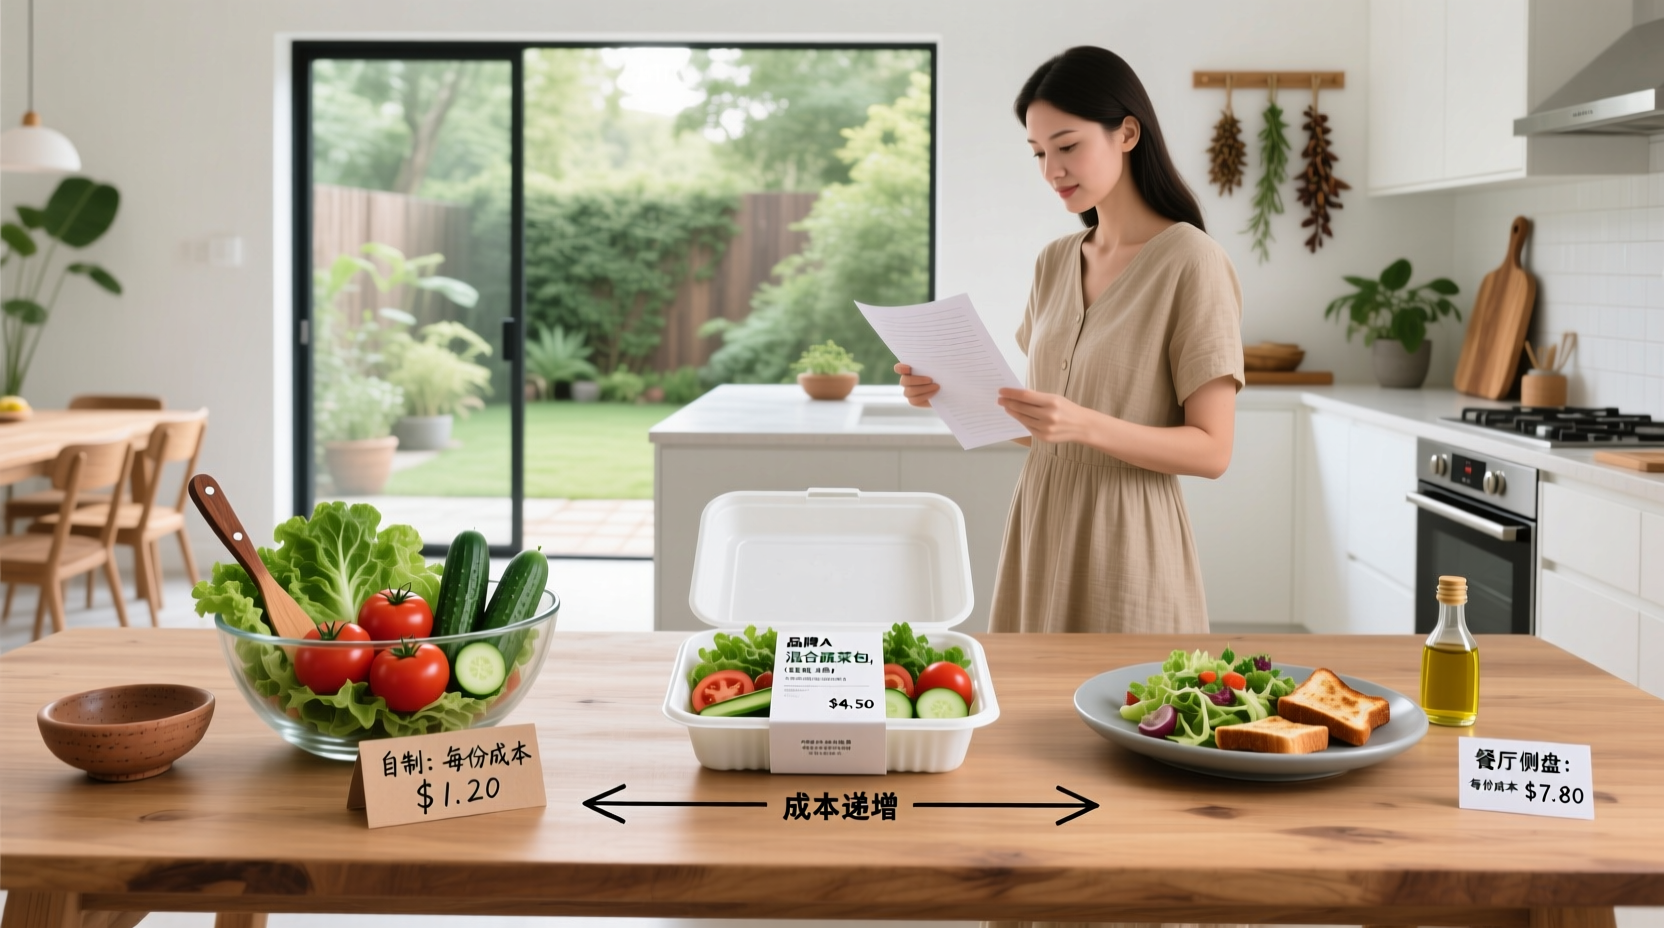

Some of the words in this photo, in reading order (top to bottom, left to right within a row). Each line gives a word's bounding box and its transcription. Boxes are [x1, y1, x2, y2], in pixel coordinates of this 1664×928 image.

[829, 698, 874, 710] $4.50
[417, 777, 500, 815] $1.20
[1525, 781, 1584, 804] $7.80
